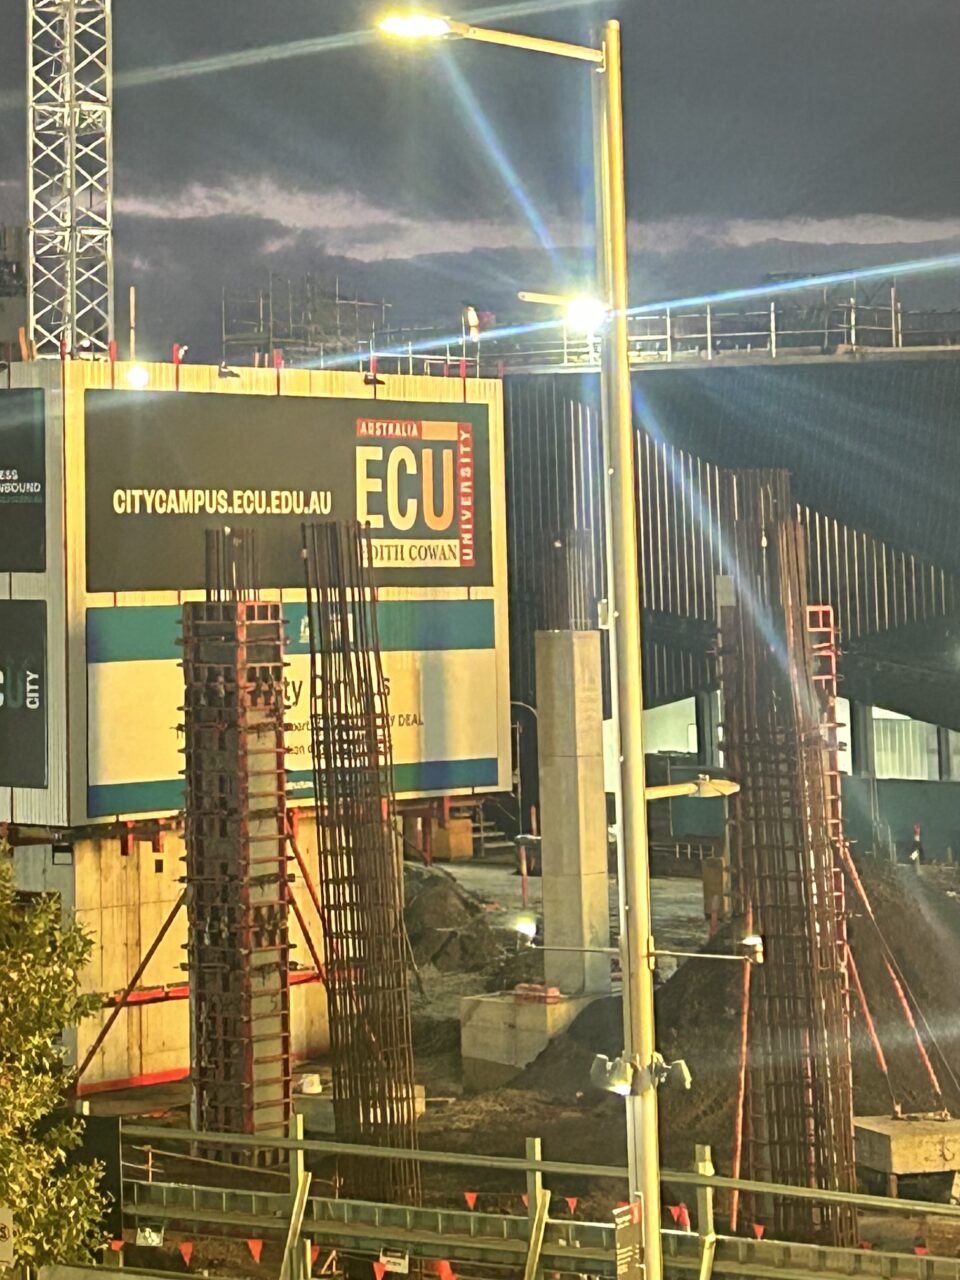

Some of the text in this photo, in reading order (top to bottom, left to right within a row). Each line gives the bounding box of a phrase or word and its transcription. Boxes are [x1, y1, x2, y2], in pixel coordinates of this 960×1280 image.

[359, 421, 418, 437] AUSTRALIA
[113, 489, 332, 515] CITYCAMPUS.ECU.EDU.AU
[356, 445, 454, 531] ECU
[460, 430, 473, 561] UNIVERSITY
[409, 544, 457, 562] COWAN
[26, 670, 40, 709] CITY
